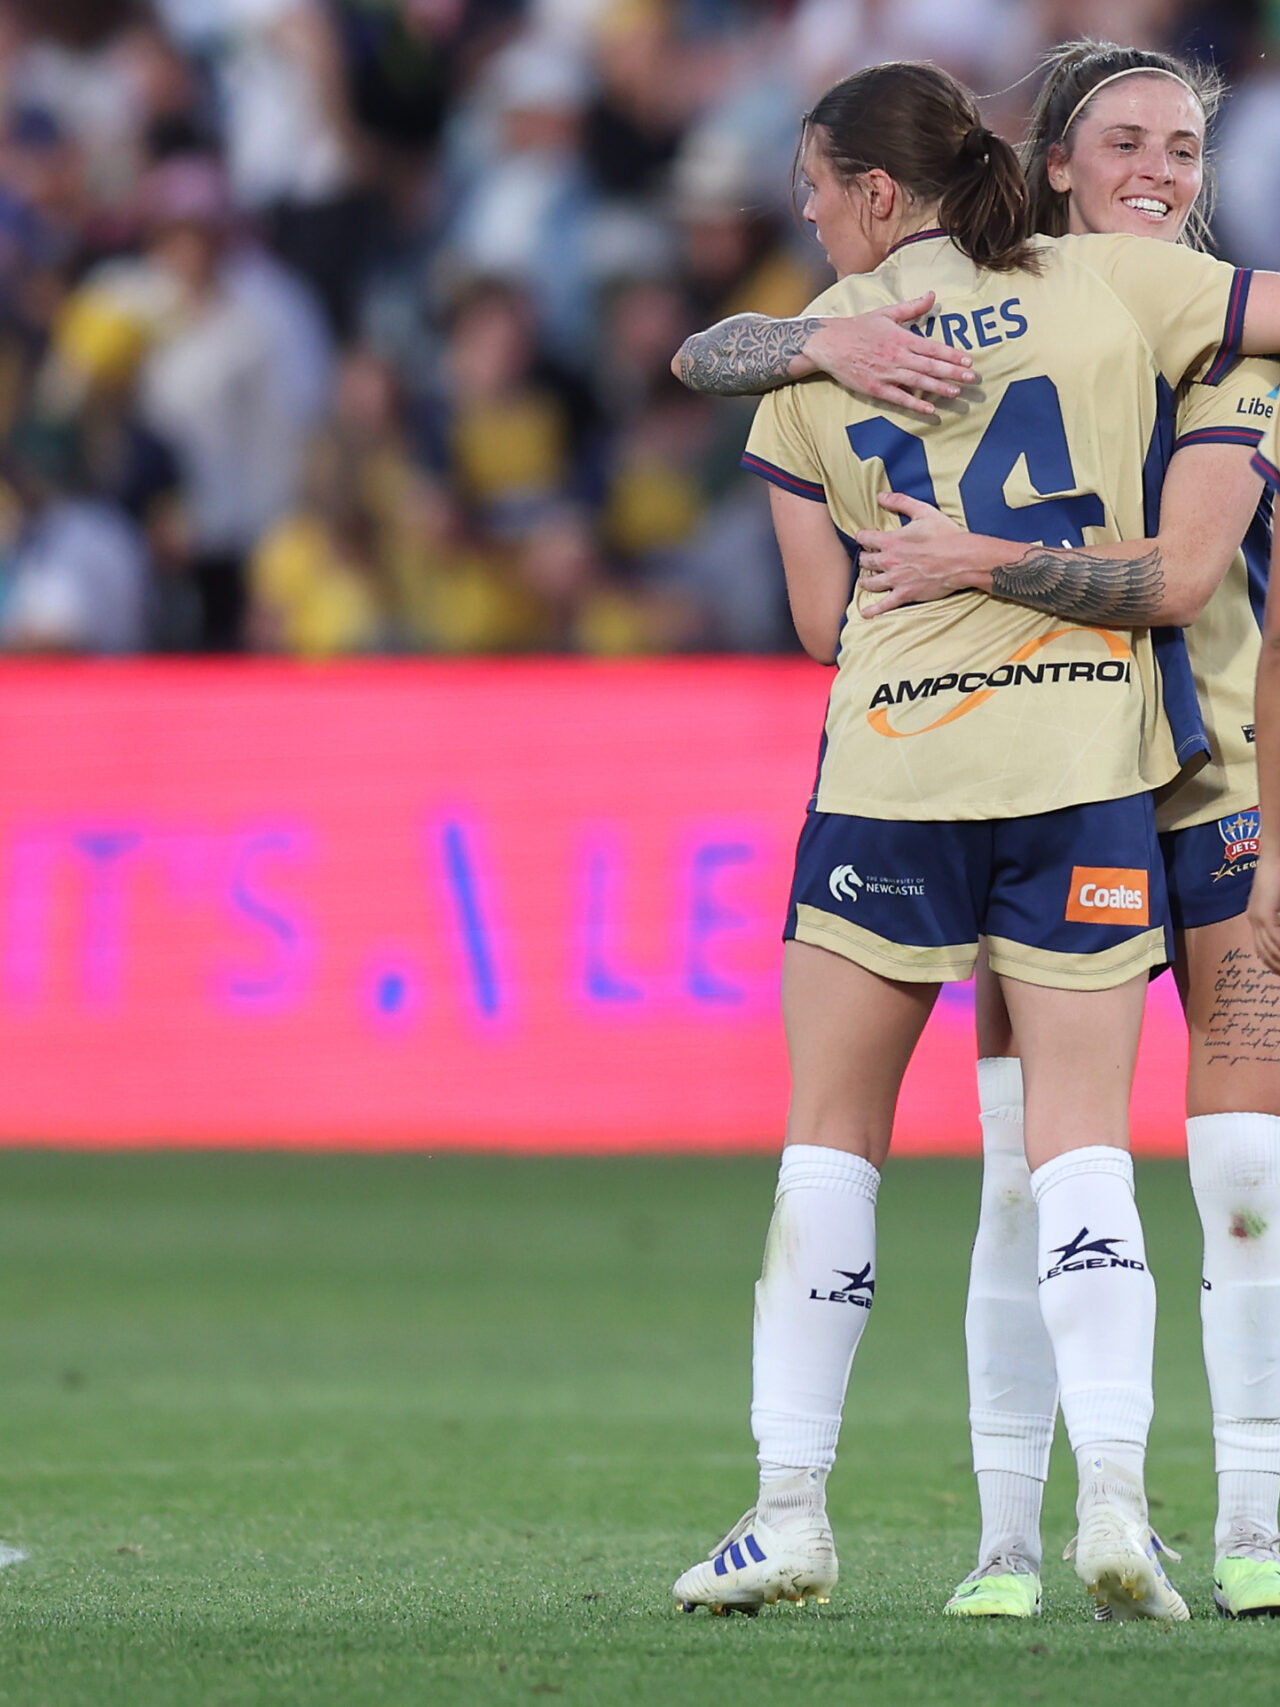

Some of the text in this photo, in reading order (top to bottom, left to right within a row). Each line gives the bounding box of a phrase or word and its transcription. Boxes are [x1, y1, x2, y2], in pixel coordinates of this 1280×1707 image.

[1231, 841, 1257, 855] JETS
[866, 883, 925, 896] NEWCASTLE
[1079, 883, 1144, 910] Coates
[1038, 1258, 1145, 1285] LEGEND
